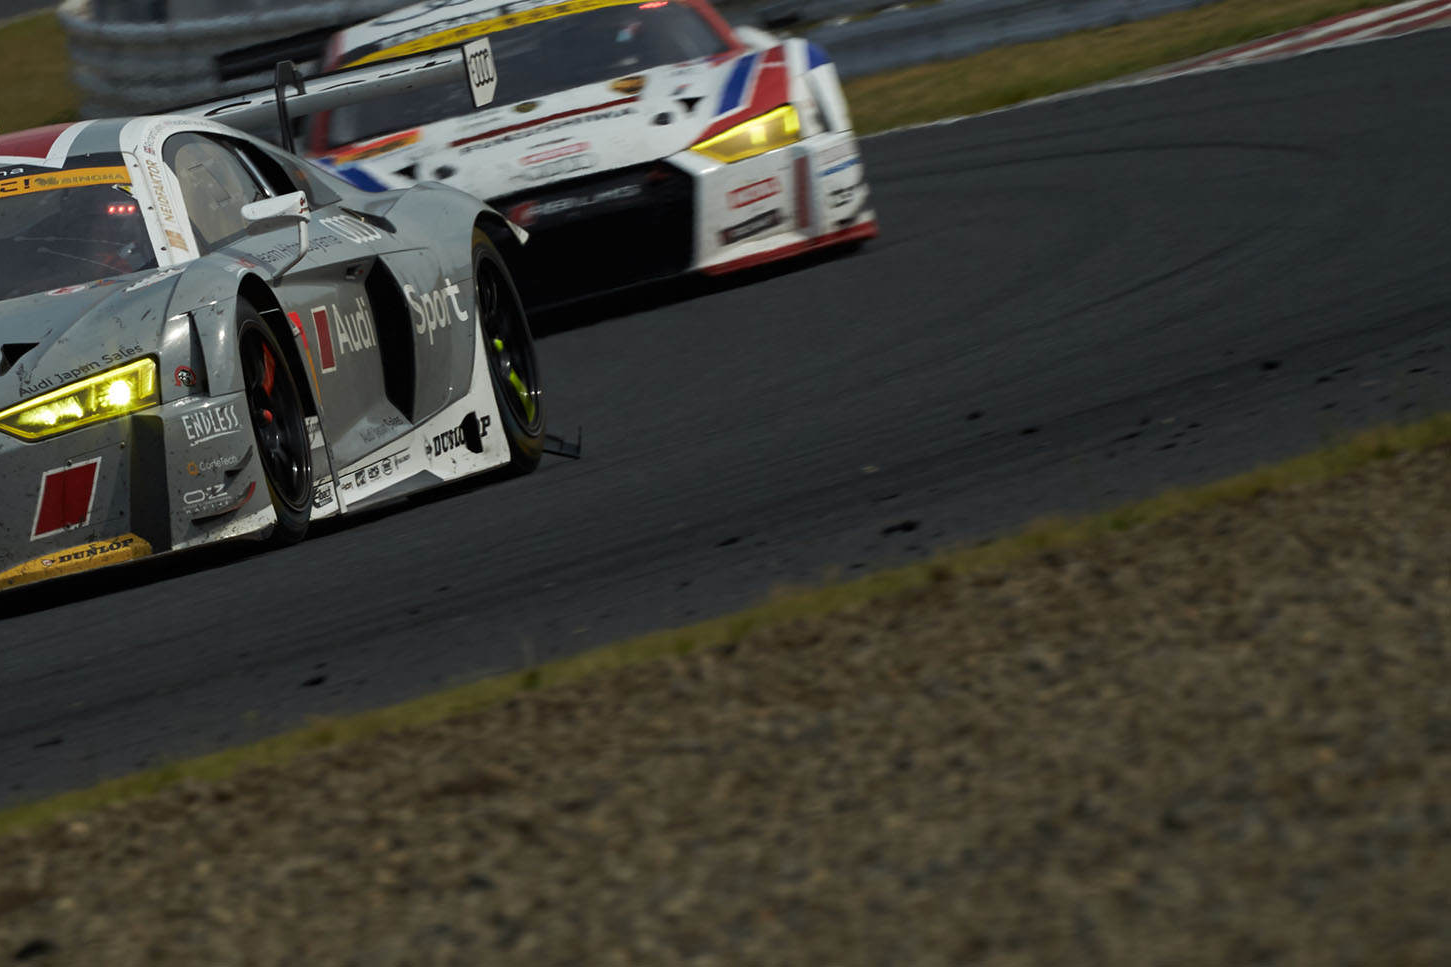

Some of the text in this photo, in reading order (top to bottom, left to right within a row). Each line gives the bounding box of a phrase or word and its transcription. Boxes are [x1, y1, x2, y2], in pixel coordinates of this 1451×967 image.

[145, 159, 174, 224] NEIDFAKTOR
[332, 278, 469, 355] Audi Sport
[19, 344, 144, 398] Audi Japan Sales
[181, 405, 239, 441] ENDLESS
[56, 537, 135, 564] DUNLOP
